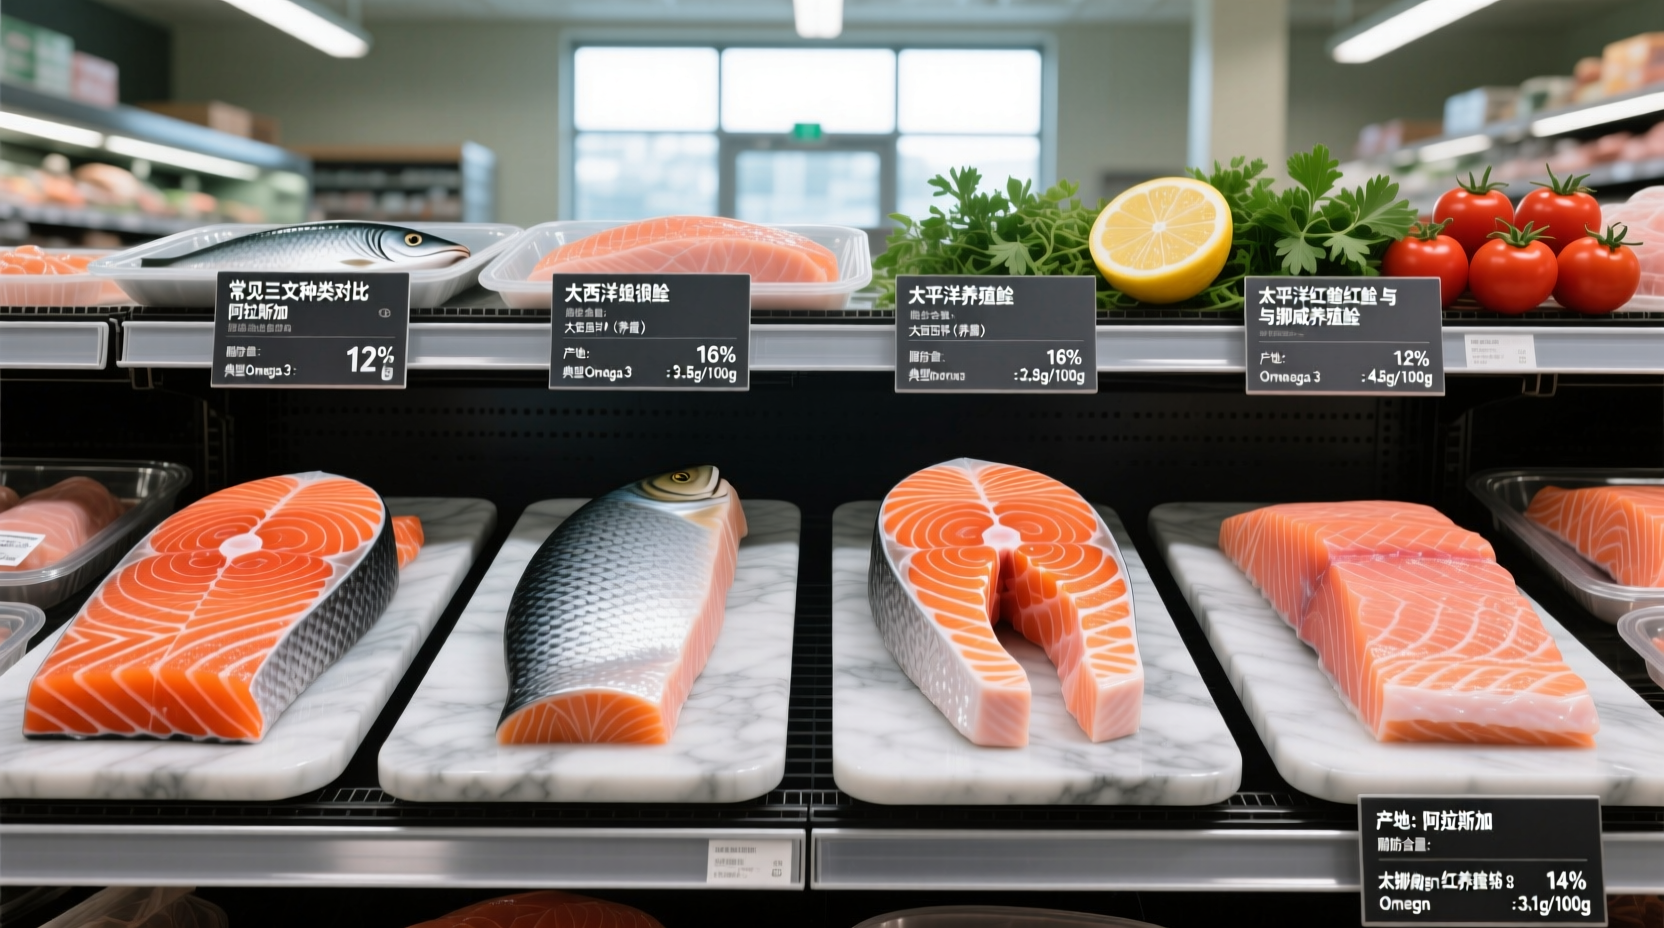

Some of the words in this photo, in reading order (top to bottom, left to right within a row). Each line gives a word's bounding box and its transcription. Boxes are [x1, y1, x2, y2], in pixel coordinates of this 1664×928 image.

[229, 279, 370, 302] 常见三文种类对比
[696, 345, 737, 364] 16%
[1046, 349, 1082, 366] 16%
[1393, 350, 1430, 367] 12%
[1546, 870, 1587, 890] 14%
